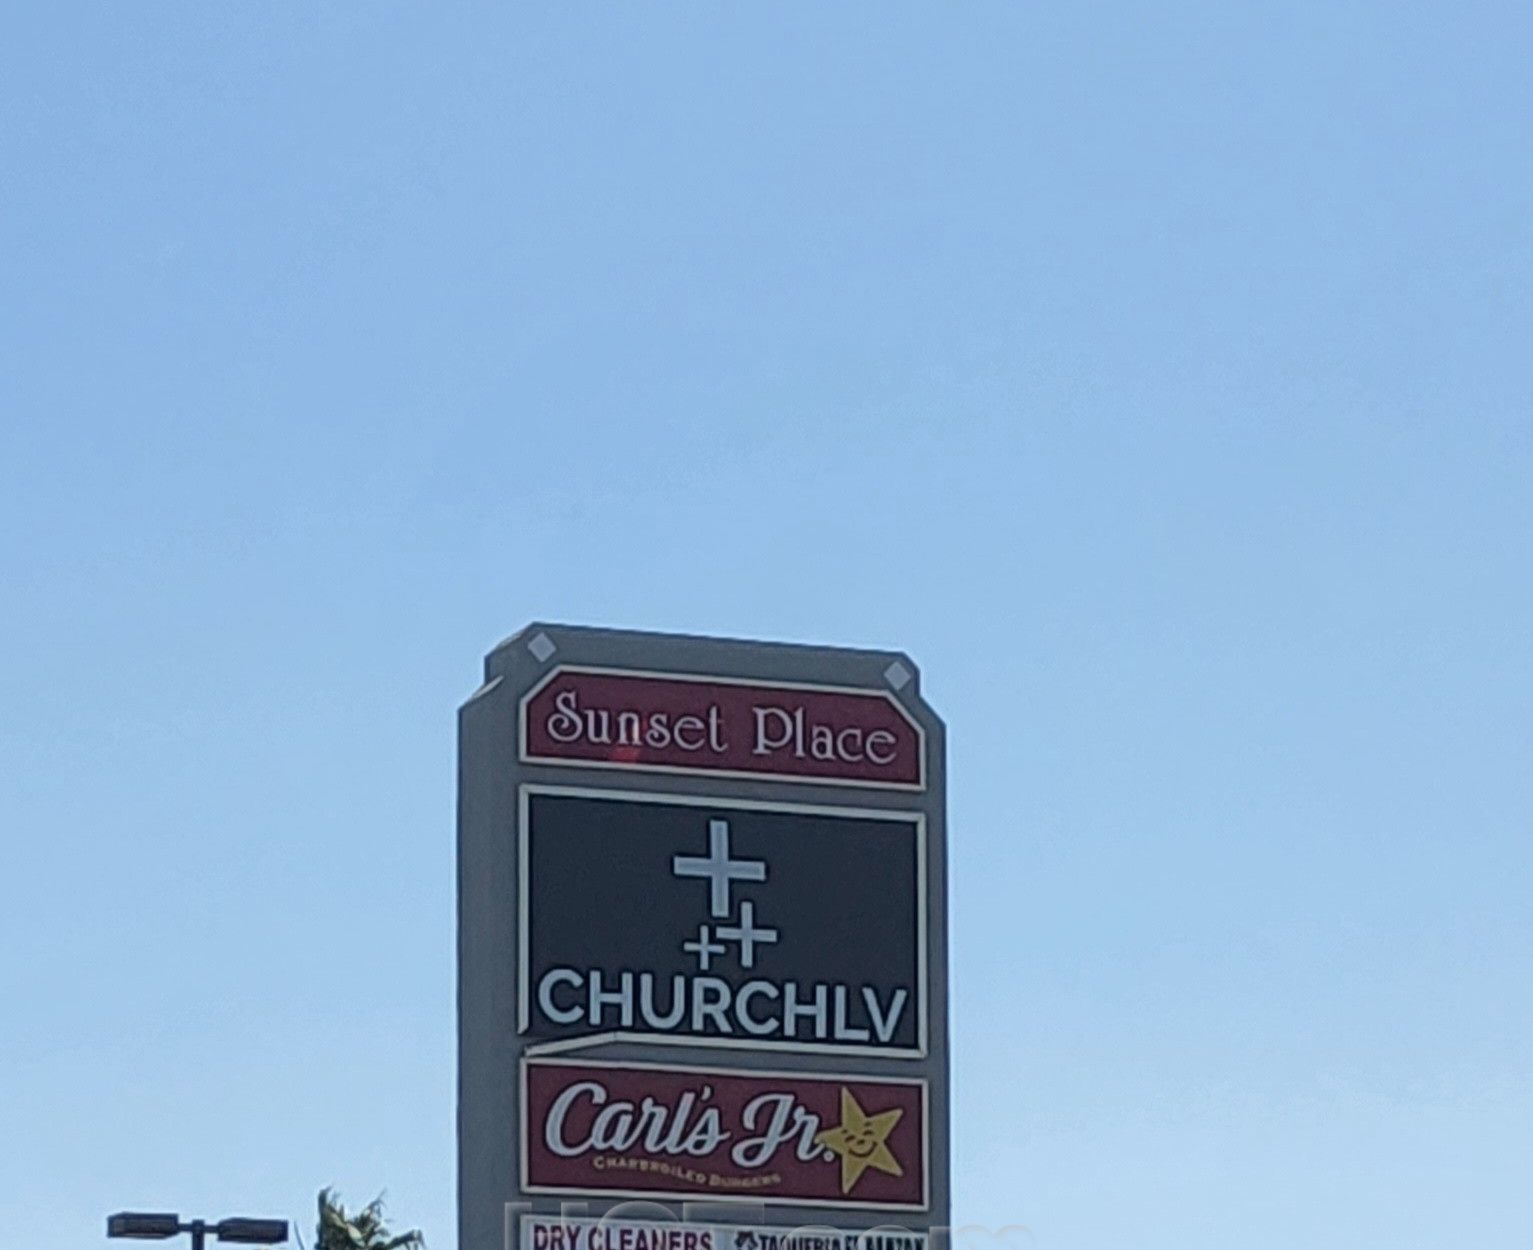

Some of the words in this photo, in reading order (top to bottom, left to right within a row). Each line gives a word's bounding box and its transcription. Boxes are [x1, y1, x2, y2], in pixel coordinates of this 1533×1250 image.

[548, 691, 728, 752] Sunset
[753, 706, 897, 764] Place
[538, 968, 907, 1042] CHURCHLV
[545, 1082, 731, 1157] Carl's
[731, 1093, 836, 1167] Jr.
